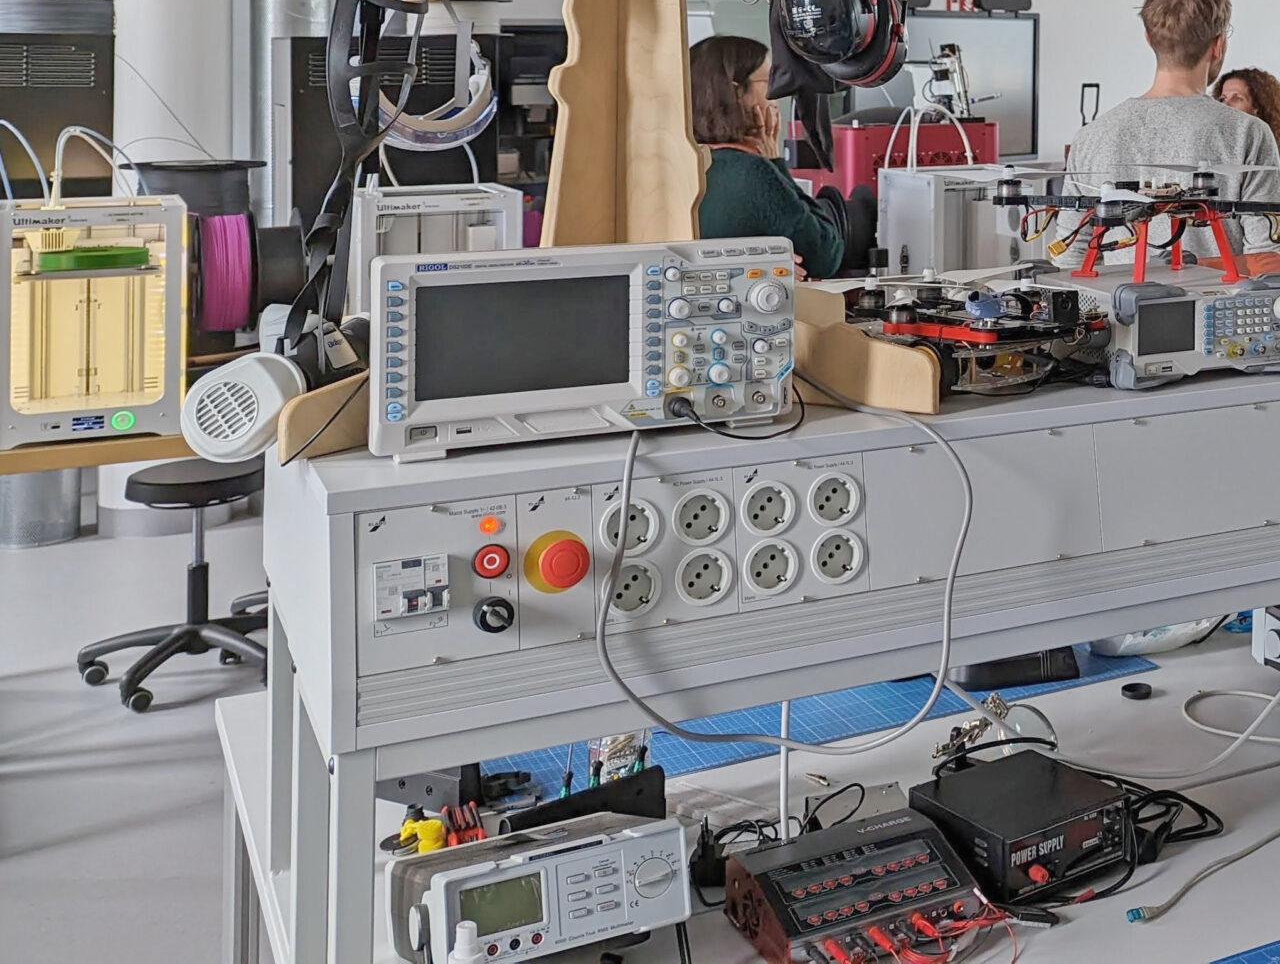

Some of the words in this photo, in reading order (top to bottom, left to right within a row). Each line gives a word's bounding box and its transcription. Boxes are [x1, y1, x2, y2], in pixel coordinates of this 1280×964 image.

[376, 203, 421, 212] Ultimaker
[12, 217, 66, 226] Ultimaker
[418, 264, 448, 272] RIGOL
[857, 816, 912, 834] V-CHARGE
[1010, 846, 1037, 868] POWER
[1038, 835, 1065, 856] SUPPLY
[568, 933, 585, 942] Counts
[585, 929, 596, 937] True
